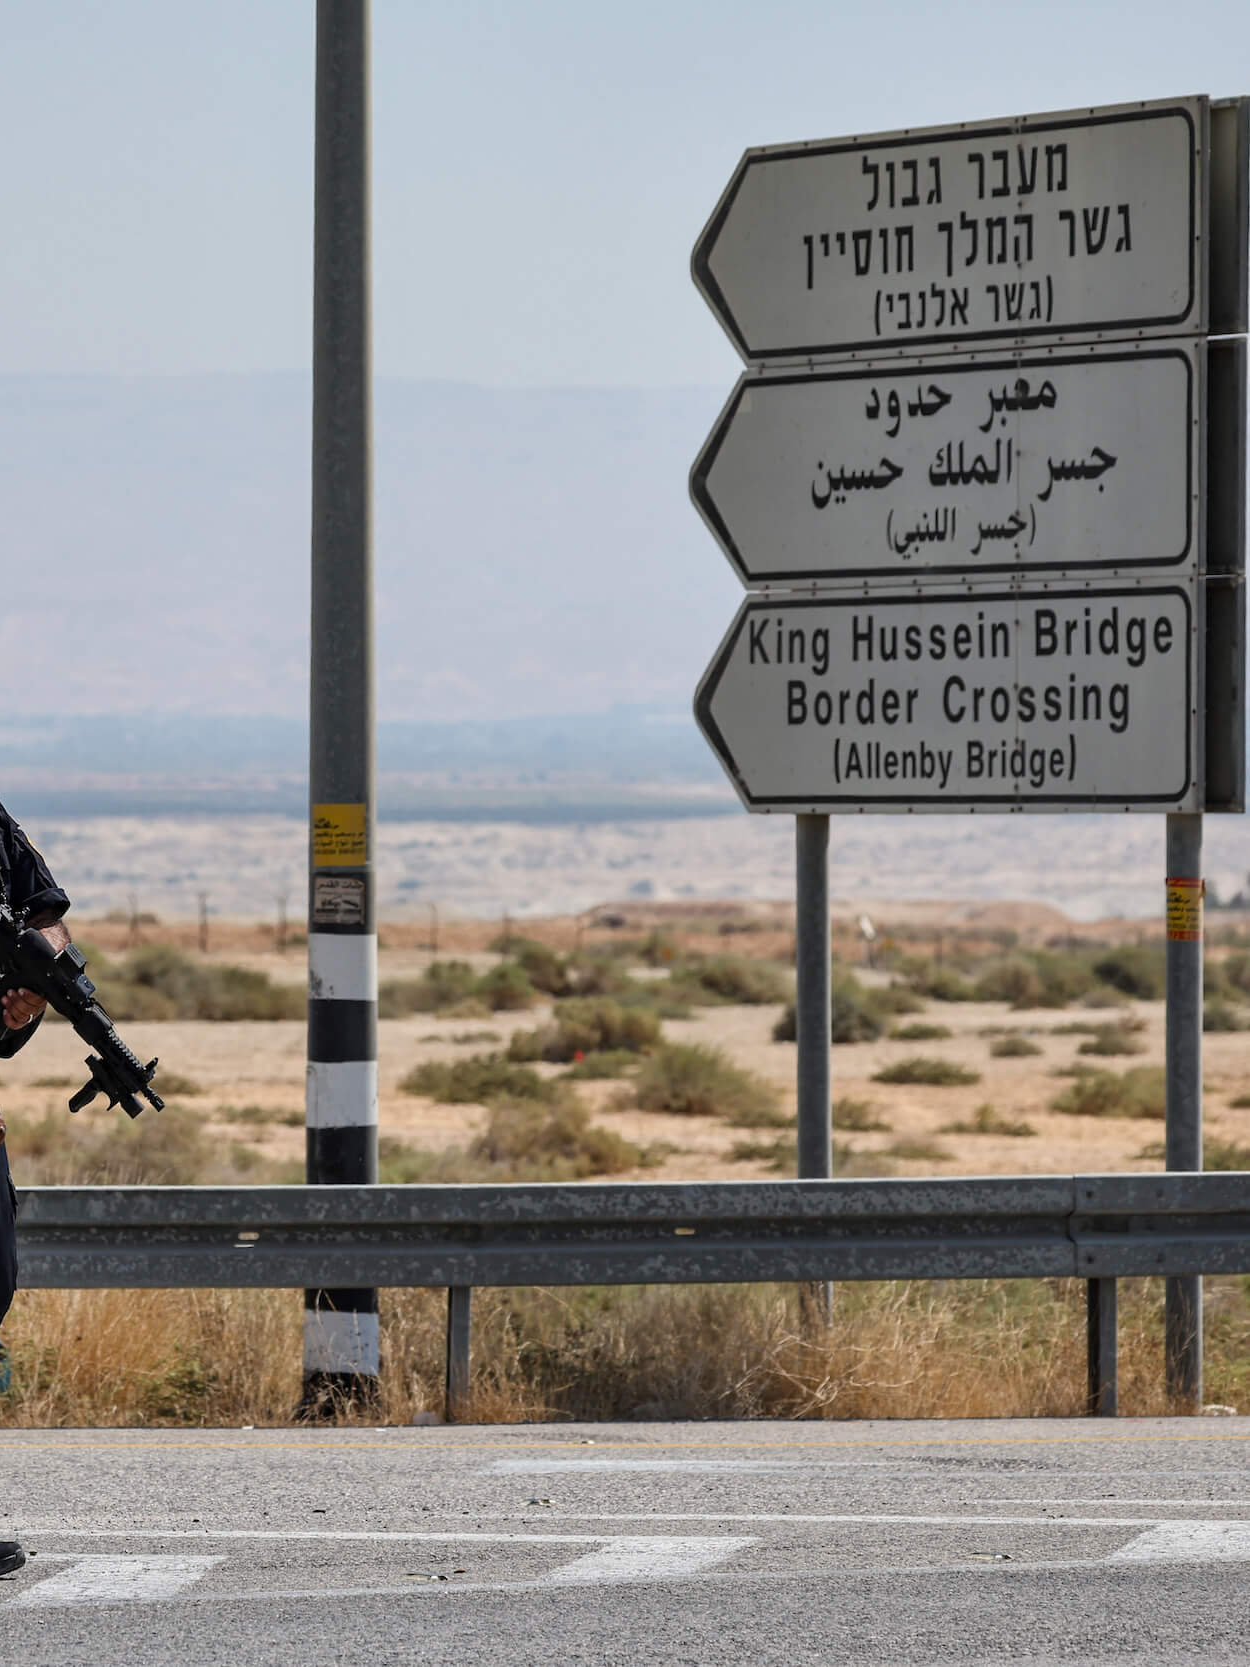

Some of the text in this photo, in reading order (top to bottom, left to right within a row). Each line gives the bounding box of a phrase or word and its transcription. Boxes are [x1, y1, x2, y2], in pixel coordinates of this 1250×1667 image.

[862, 144, 1067, 211] מעבר גבול
[804, 204, 1131, 289] גשר המלך חוסיין
[875, 276, 1052, 335] (גשר אלנבי)
[866, 379, 1056, 437] معبر حدود
[812, 438, 1116, 509] جسر الملك حسين
[887, 504, 1035, 559] (جسر اللنبي)
[750, 607, 1172, 675] King Hussein Bridge
[788, 674, 1128, 733] Border Crossing
[835, 734, 1076, 790] (Allenby Bridge)
